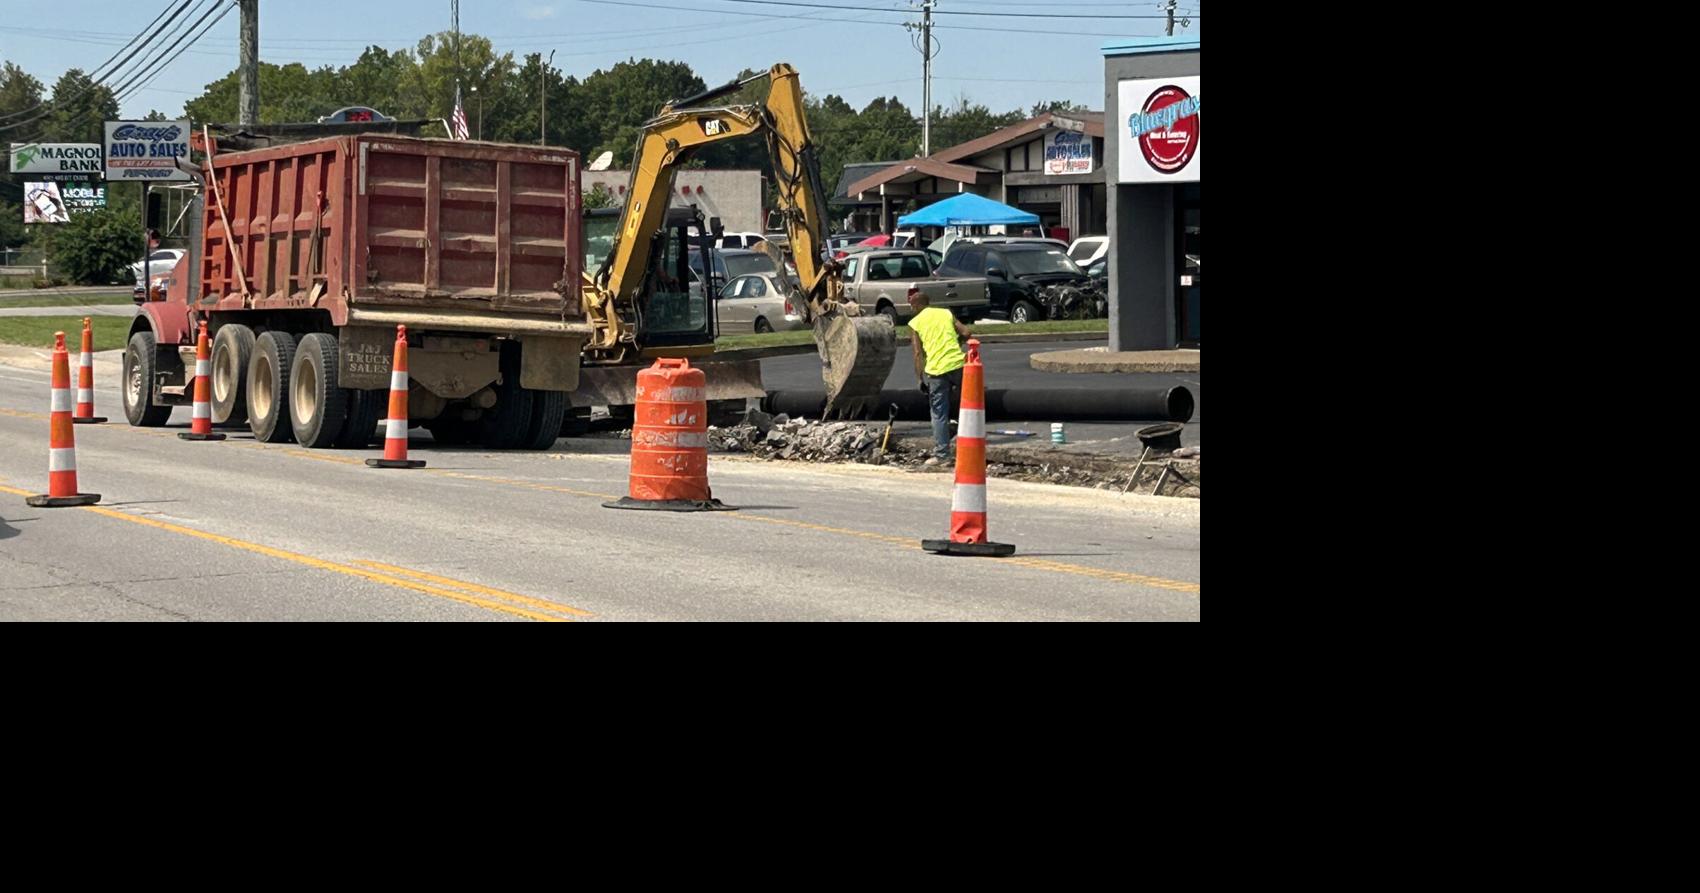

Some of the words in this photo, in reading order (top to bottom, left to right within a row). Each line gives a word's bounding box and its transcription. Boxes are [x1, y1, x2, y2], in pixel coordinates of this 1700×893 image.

[705, 119, 720, 136] CAT
[110, 142, 146, 158] AUTO
[149, 142, 187, 158] SALES
[60, 160, 99, 171] BANK
[347, 352, 391, 364] TRUCK
[349, 362, 388, 374] SALES
